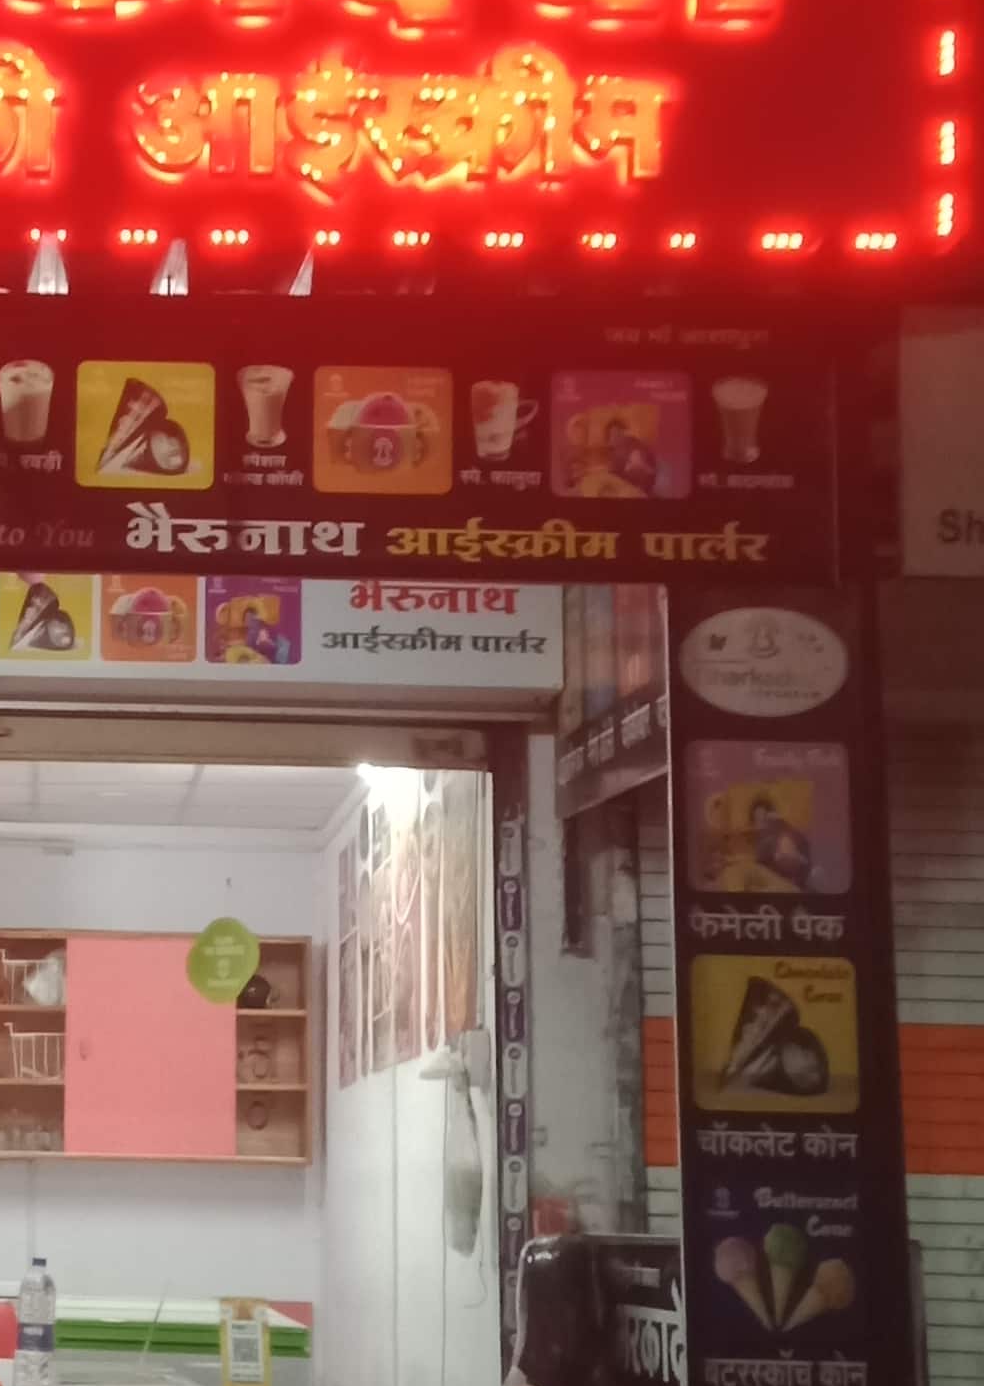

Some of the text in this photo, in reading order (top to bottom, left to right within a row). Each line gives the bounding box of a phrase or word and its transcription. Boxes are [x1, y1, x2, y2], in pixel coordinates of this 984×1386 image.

[385, 516, 620, 562] आईस्क्रीम
[641, 520, 768, 561] पार्लर
[803, 1124, 858, 1158] कोन
